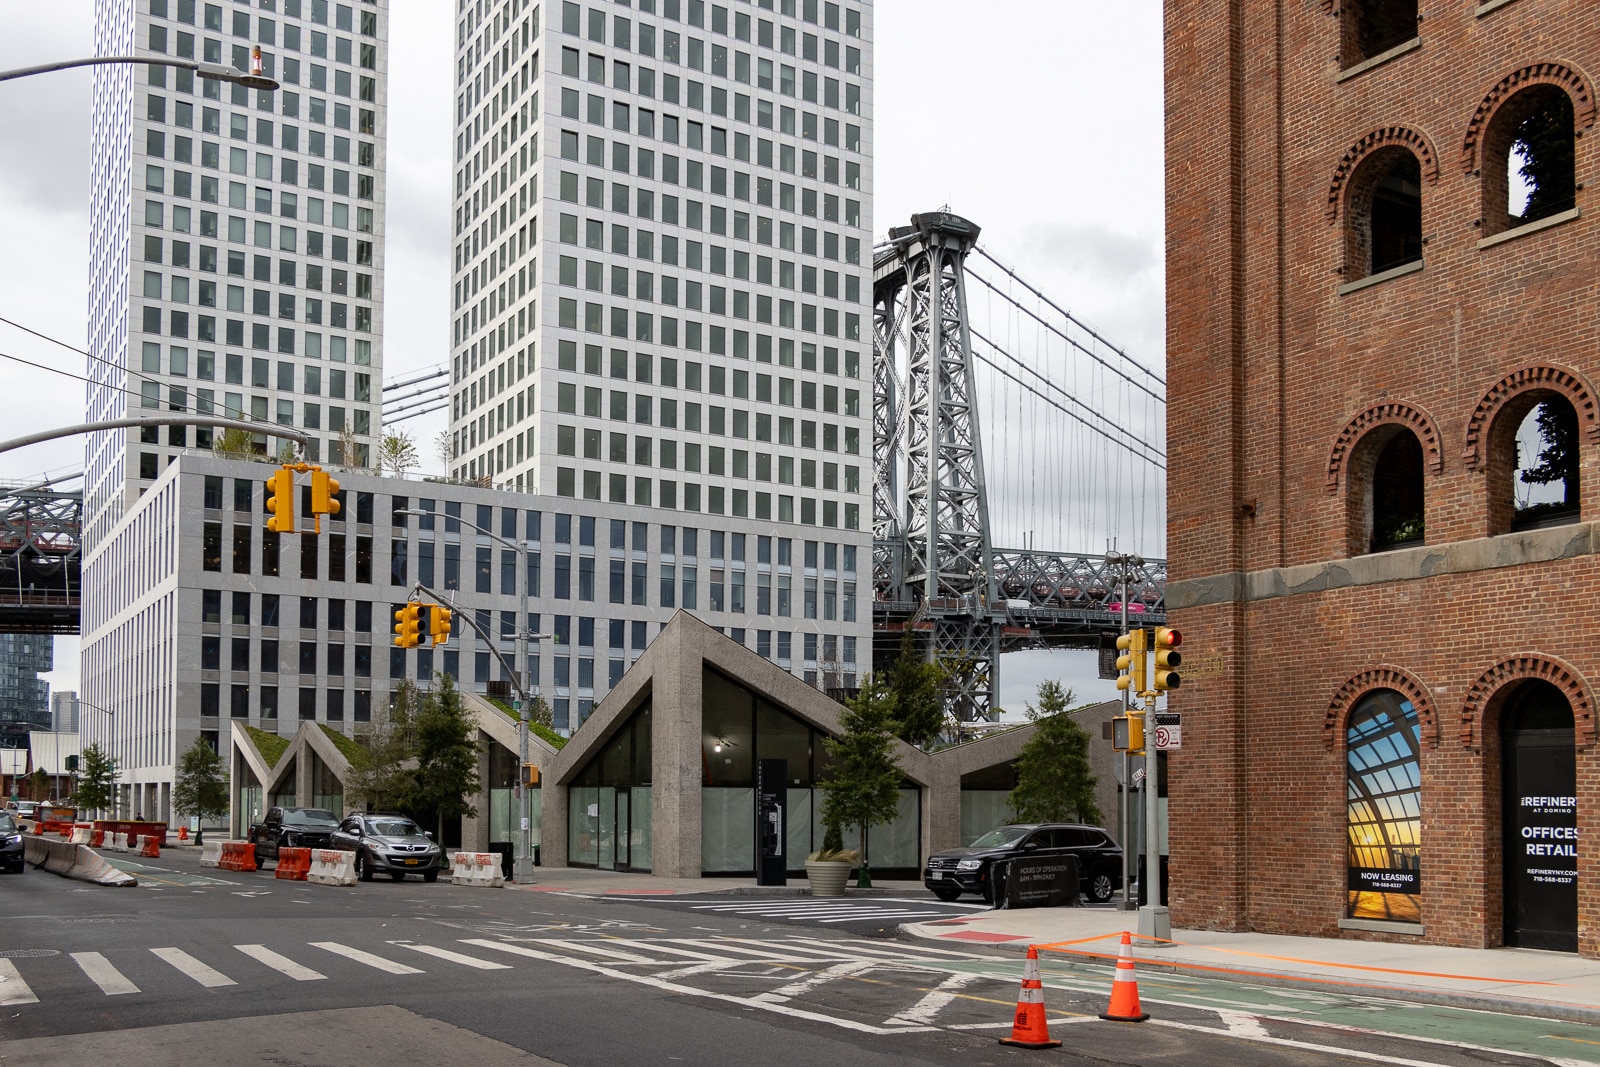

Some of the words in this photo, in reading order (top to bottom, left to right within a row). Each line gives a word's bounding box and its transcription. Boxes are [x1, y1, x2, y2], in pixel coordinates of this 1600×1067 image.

[1525, 796, 1577, 807] REFINER
[1526, 844, 1578, 856] RETAIL
[1361, 872, 1380, 880] NOW
[1381, 873, 1414, 882] LEASING
